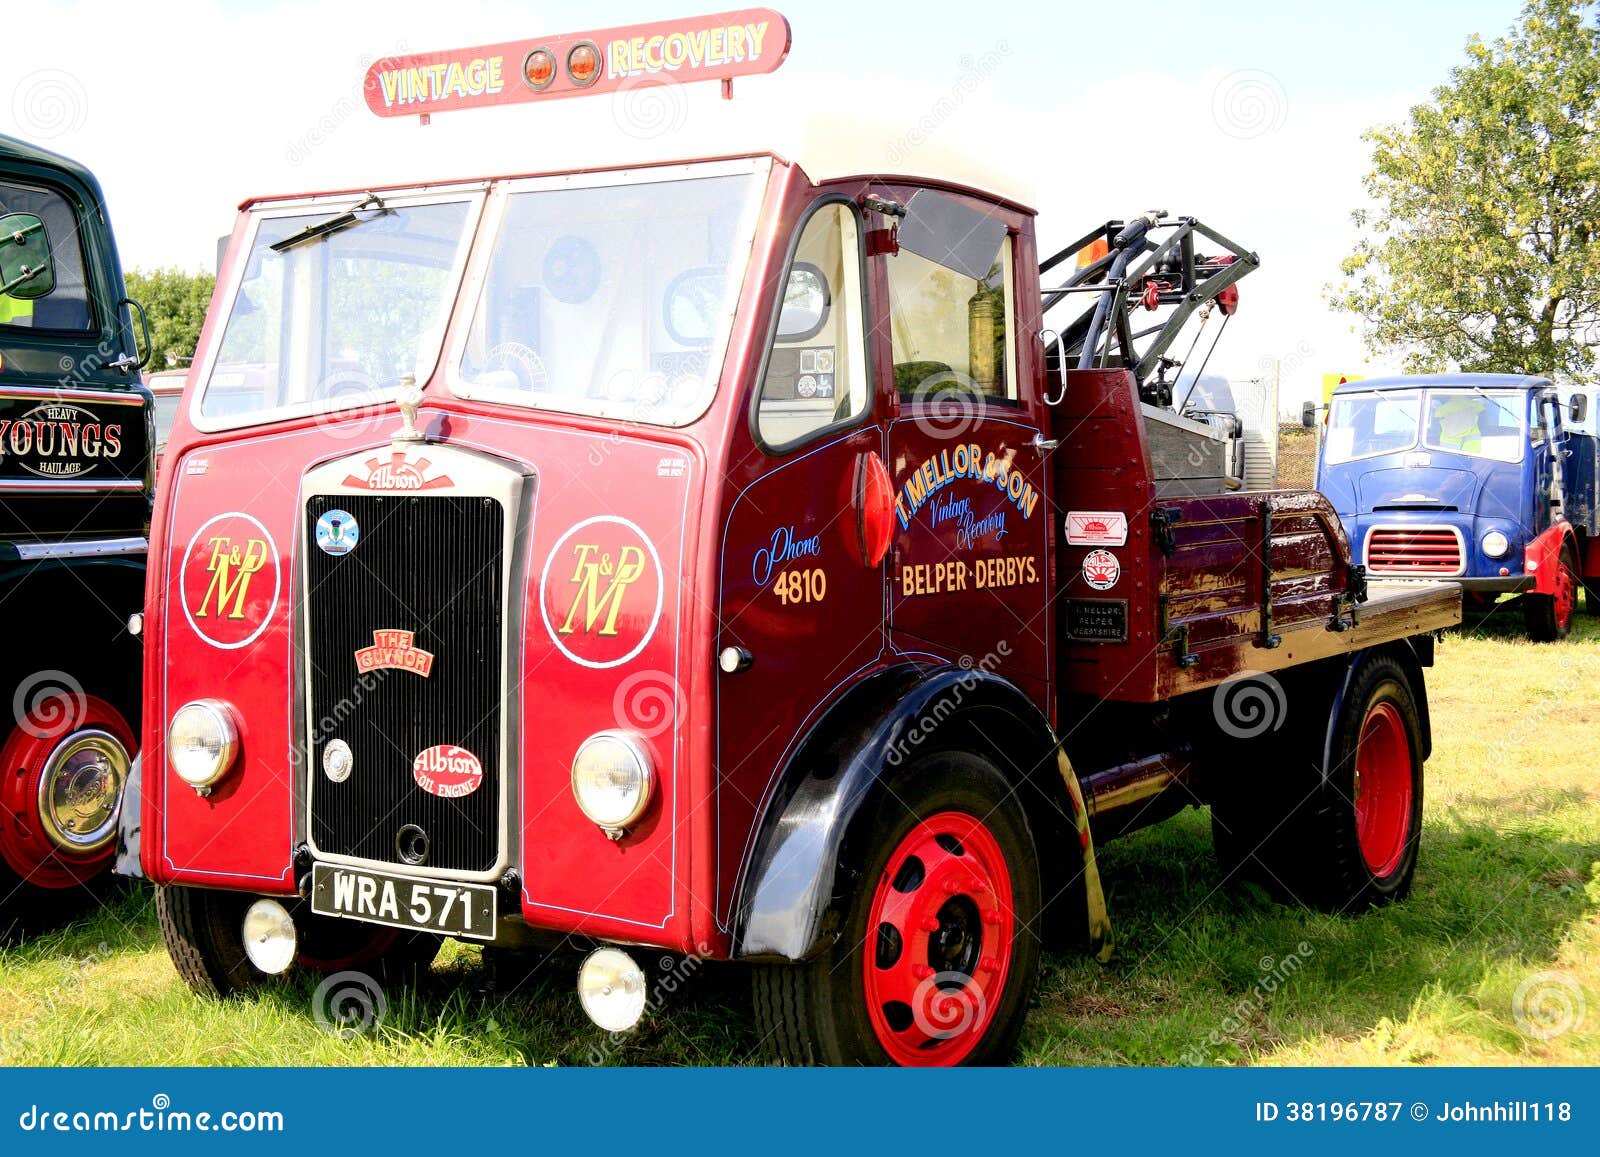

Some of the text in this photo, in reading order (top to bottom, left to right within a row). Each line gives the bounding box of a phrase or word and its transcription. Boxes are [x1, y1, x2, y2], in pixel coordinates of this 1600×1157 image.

[380, 22, 769, 106] VINTAGE RECOVERY
[48, 408, 77, 421] HEAVY
[39, 462, 81, 474] HAULAGE
[369, 463, 424, 489] Albion
[930, 492, 971, 528] Vintage
[957, 512, 1008, 550] Recovery
[752, 526, 821, 586] Phone
[773, 568, 827, 605] 4810
[378, 632, 409, 649] THE
[413, 746, 482, 775] Albion
[418, 774, 475, 797] OIL ENGINE
[333, 871, 473, 929] WRA 571
